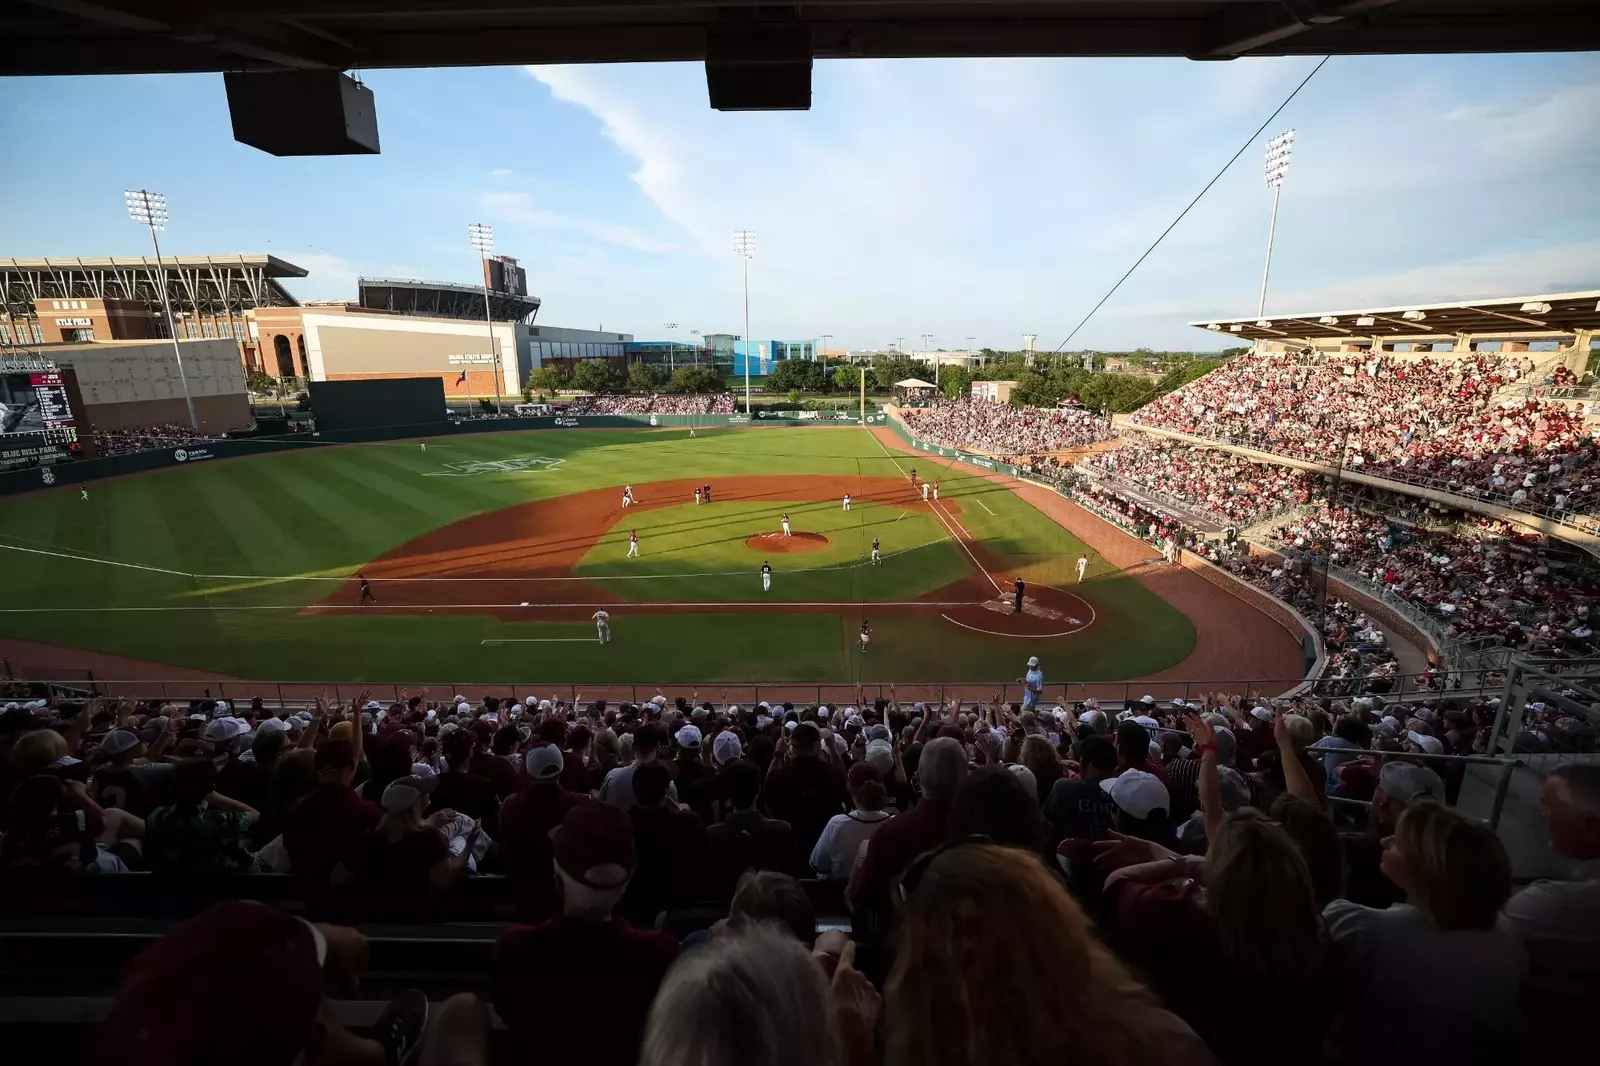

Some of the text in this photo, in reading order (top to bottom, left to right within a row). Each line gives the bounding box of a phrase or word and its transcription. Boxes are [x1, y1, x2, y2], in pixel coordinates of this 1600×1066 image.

[2, 449, 21, 458] BLUE
[21, 447, 39, 456] BELL
[39, 445, 57, 455] PARK
